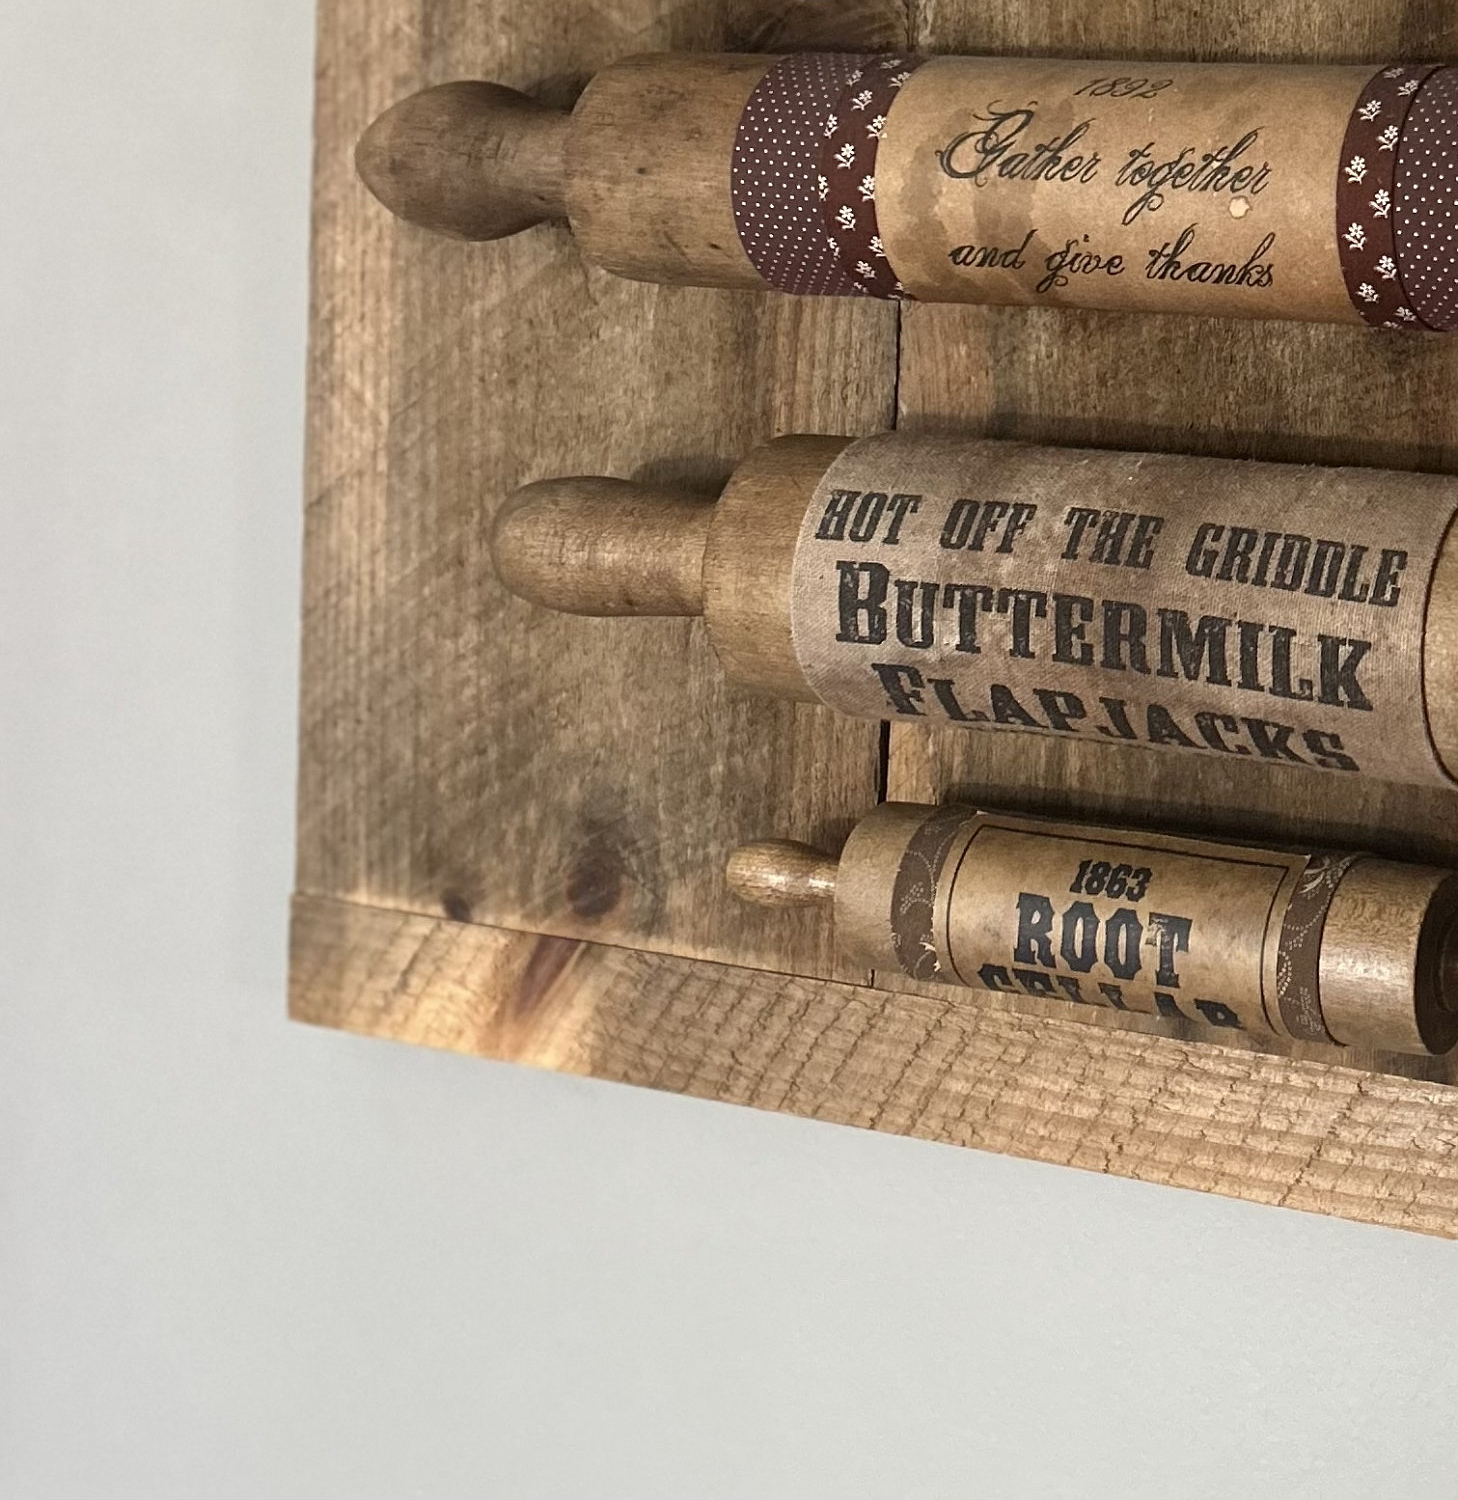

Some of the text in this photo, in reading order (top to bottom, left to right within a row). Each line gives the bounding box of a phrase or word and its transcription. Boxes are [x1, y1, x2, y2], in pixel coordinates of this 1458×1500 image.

[935, 100, 1274, 226] Gather together
[949, 222, 1277, 294] and give thanks
[815, 489, 1407, 607] HOT OFF THE GRIDDLE
[1069, 859, 1153, 902] 1863
[1013, 892, 1193, 989] ROOT
